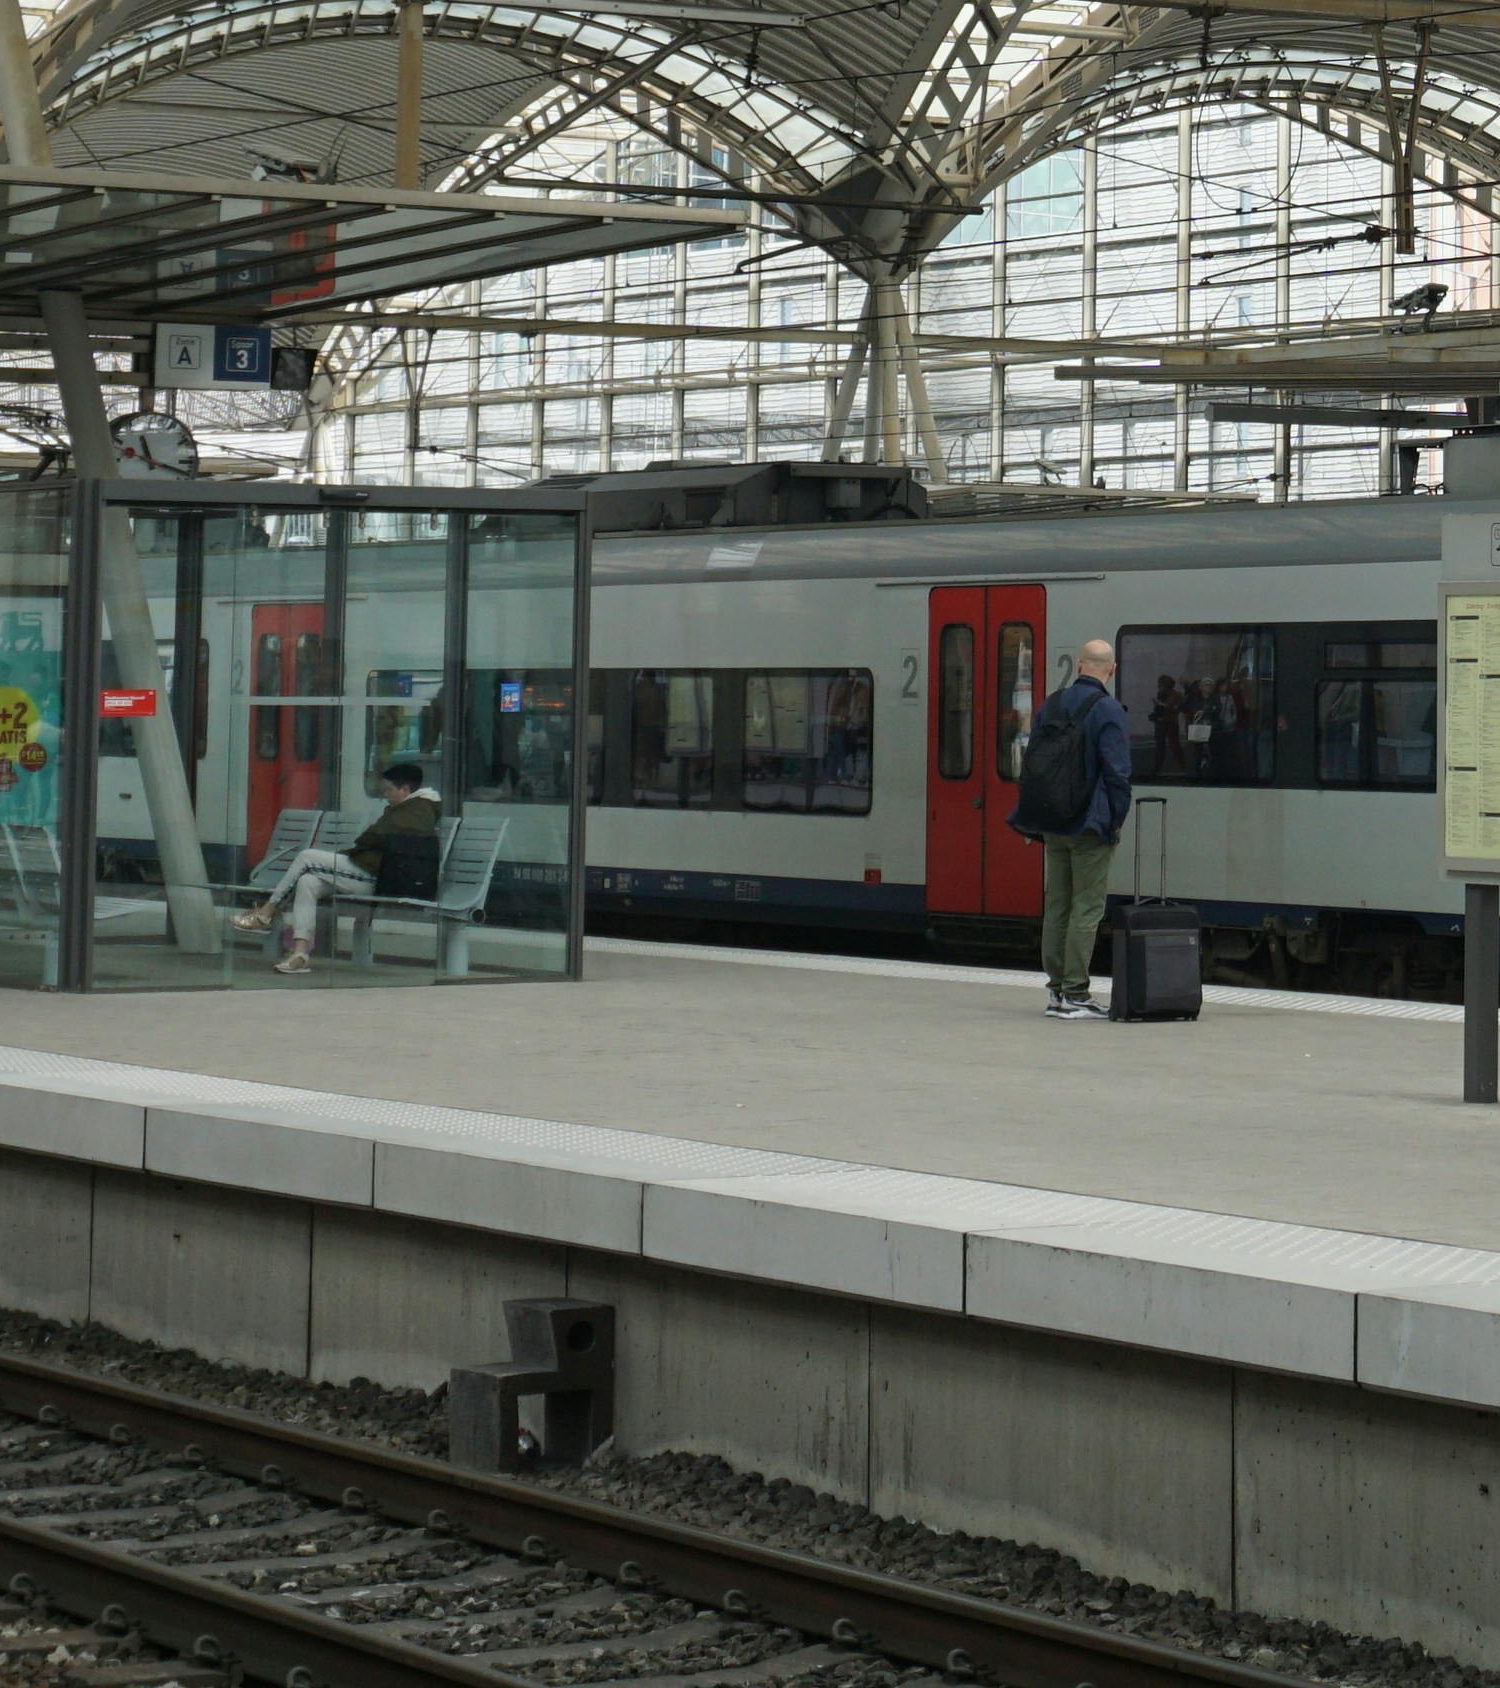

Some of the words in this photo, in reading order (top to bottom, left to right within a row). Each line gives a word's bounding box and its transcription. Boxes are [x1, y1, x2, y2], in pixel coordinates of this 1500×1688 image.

[177, 346, 192, 365] A
[236, 350, 248, 369] 3
[902, 655, 918, 699] 2
[1057, 654, 1074, 689] 2
